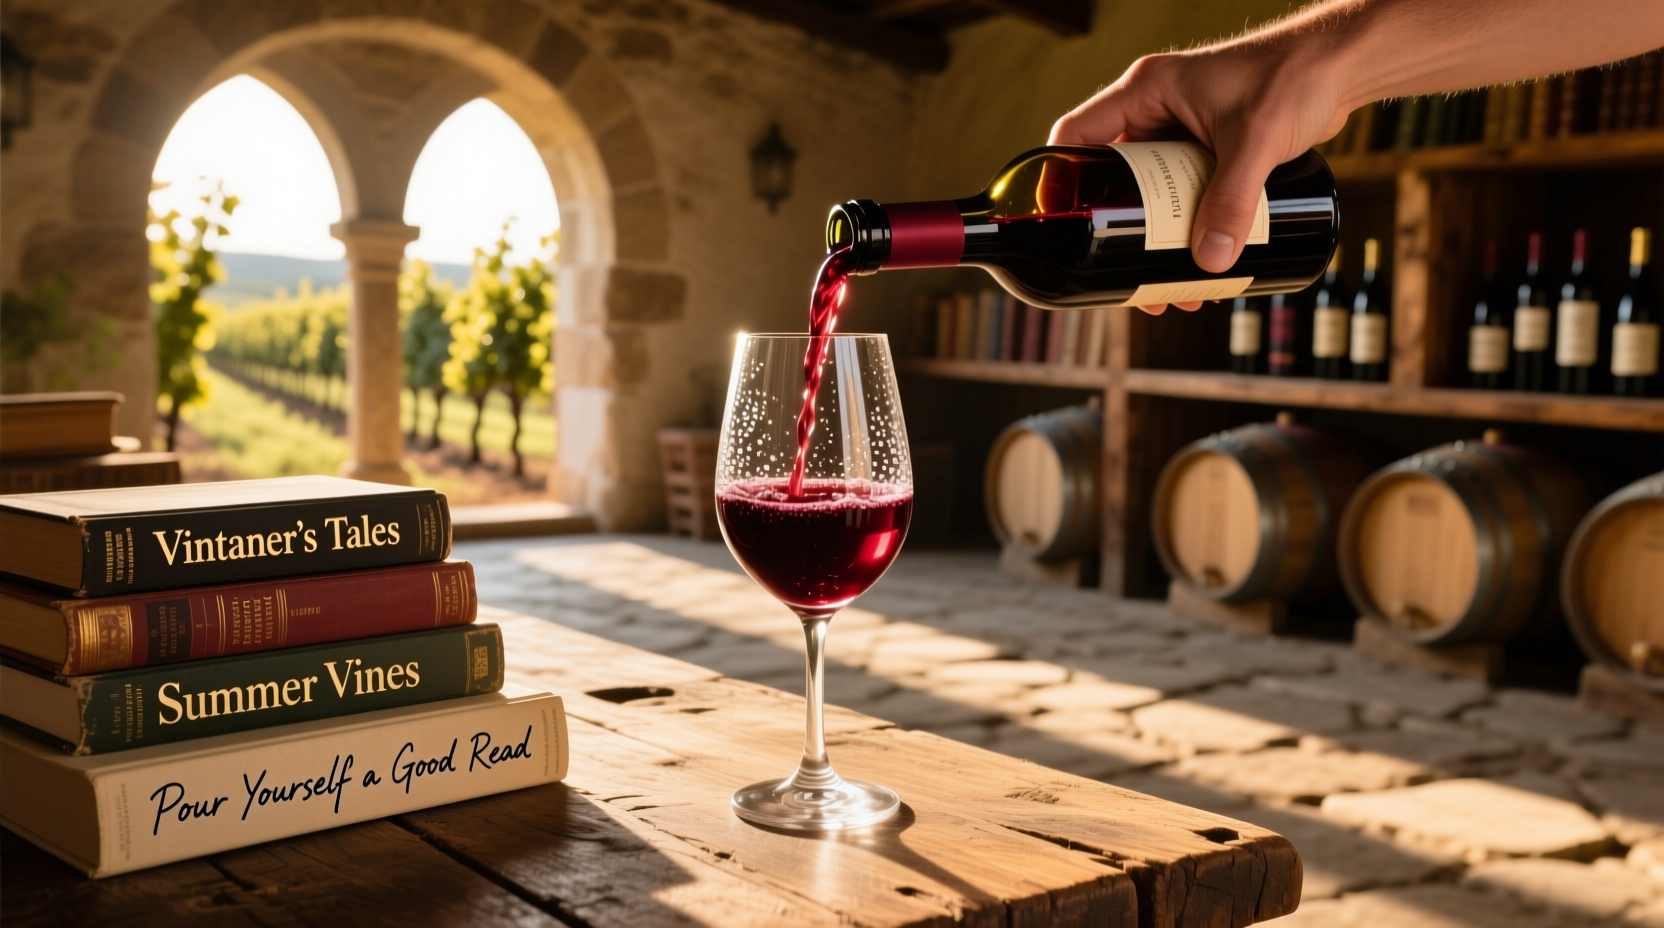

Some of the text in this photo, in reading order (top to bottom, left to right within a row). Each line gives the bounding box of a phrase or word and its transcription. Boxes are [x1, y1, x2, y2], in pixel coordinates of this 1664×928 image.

[152, 519, 318, 566] Vintaner's
[324, 514, 401, 551] Tales
[157, 674, 318, 725] Summer
[324, 658, 421, 699] Vines
[149, 782, 229, 836] Pour
[241, 754, 354, 821] Yourself
[362, 769, 382, 788] a
[391, 738, 458, 794] Good
[469, 724, 533, 773] Read
